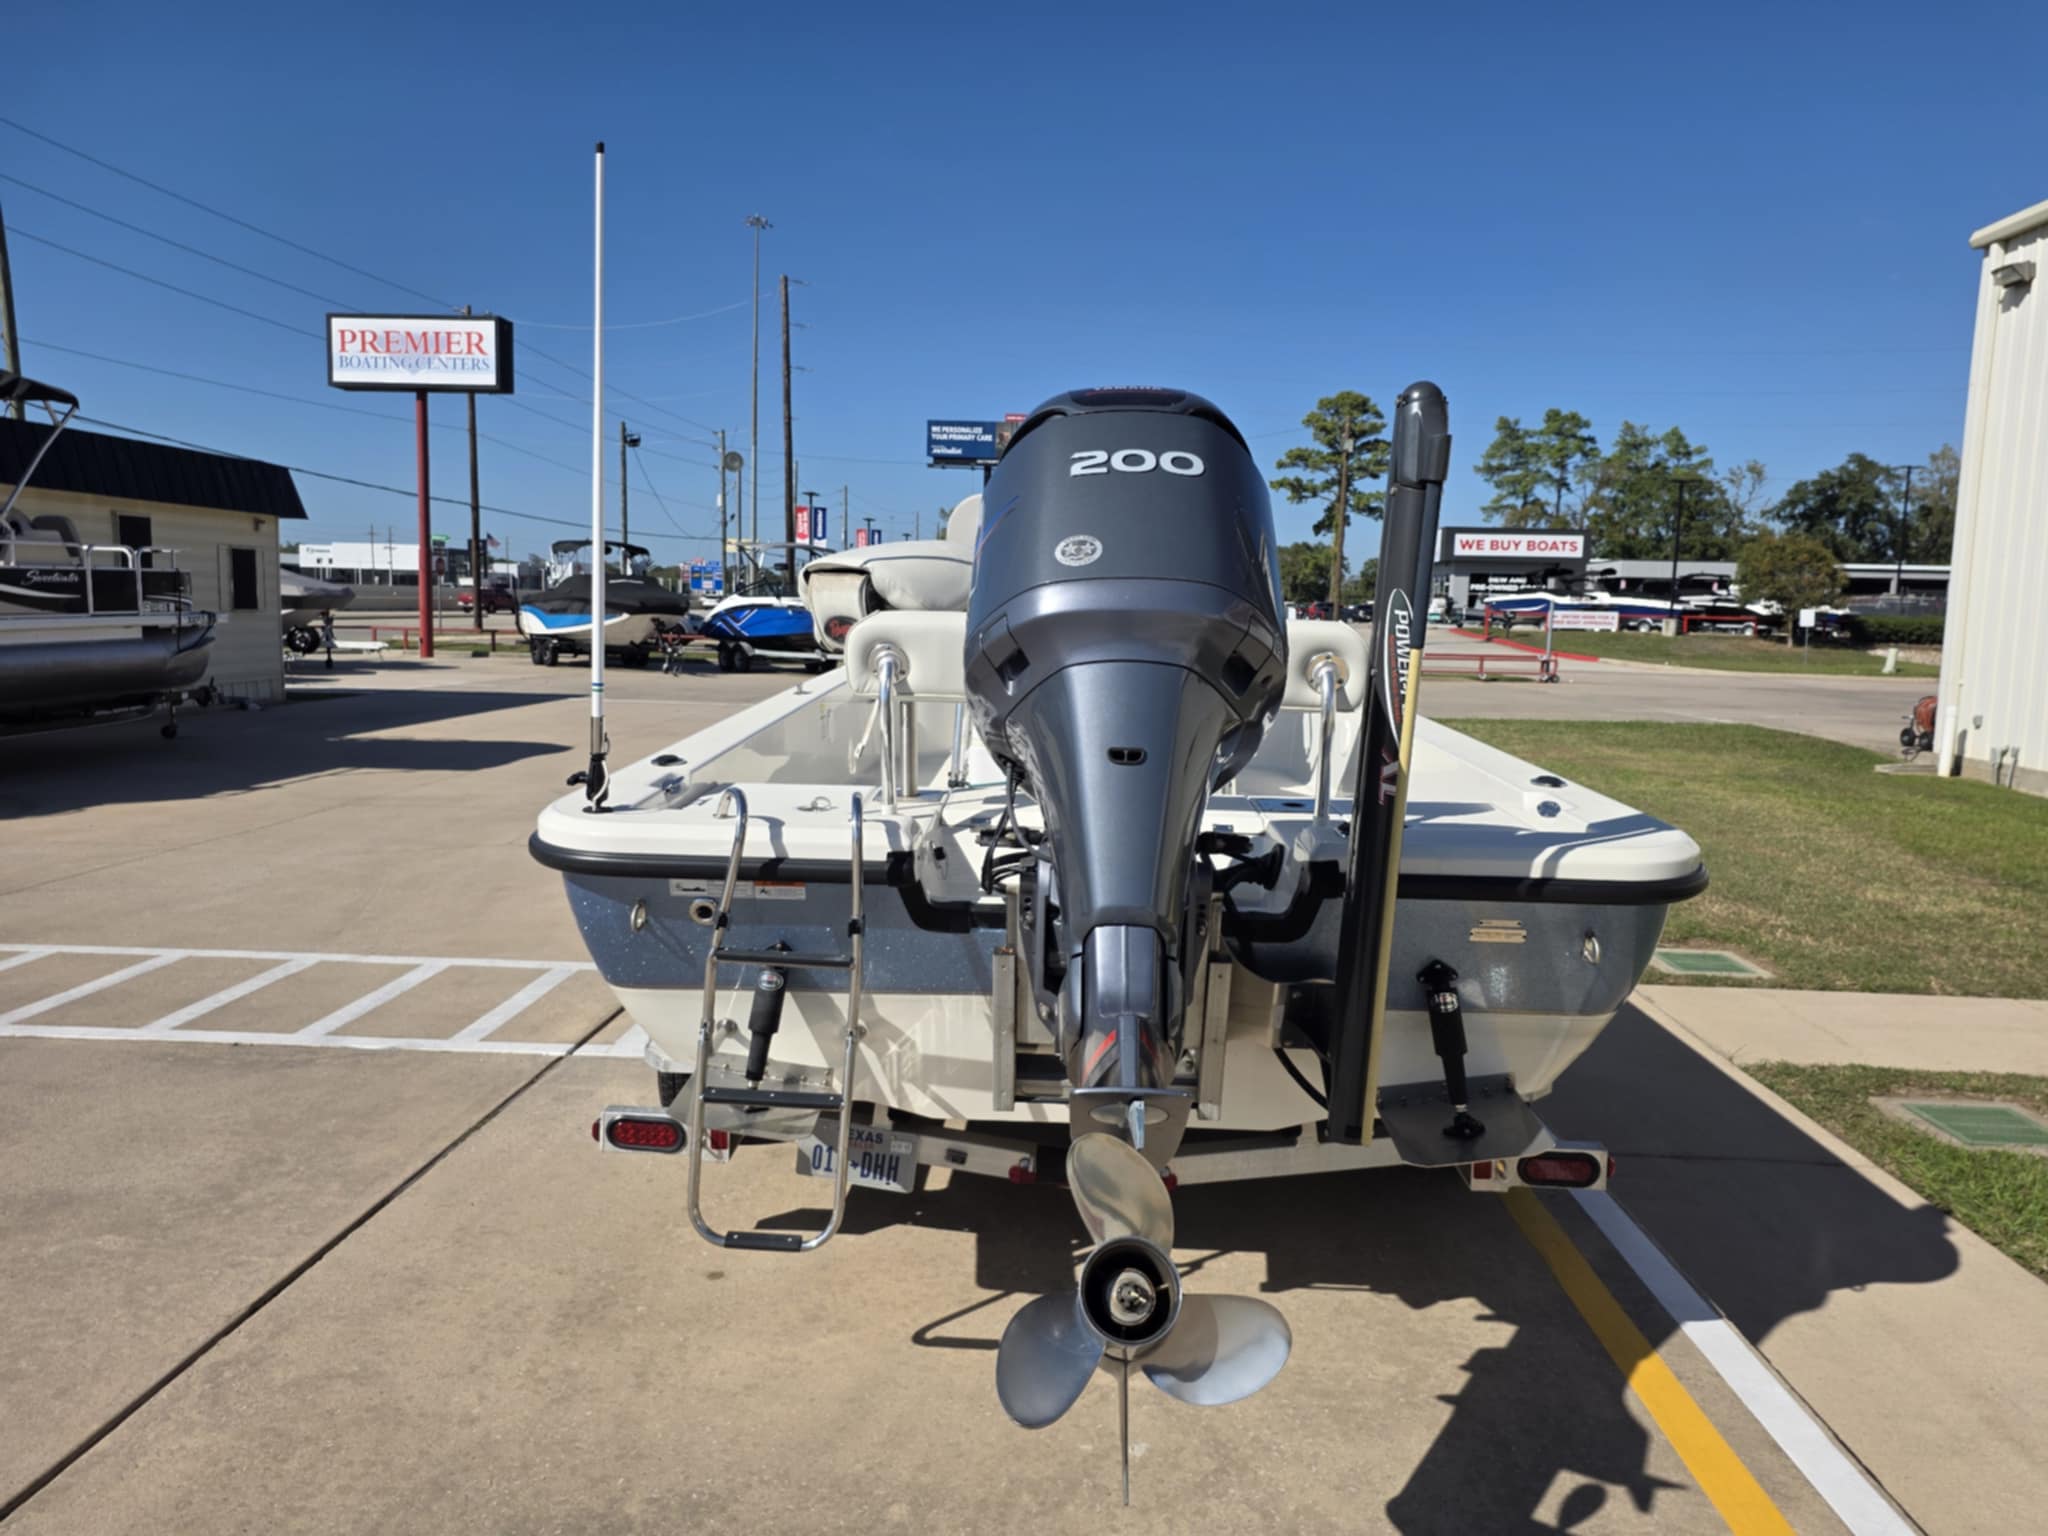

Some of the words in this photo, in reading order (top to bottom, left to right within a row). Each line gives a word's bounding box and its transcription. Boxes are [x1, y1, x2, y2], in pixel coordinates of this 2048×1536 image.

[337, 329, 489, 356] PREMIER
[339, 355, 412, 370] BOATING
[415, 356, 490, 371] CENTERS
[949, 433, 976, 441] PRIMARY
[976, 434, 993, 442] CARE
[1070, 448, 1205, 477] 200
[1460, 538, 1485, 550] WE
[1490, 539, 1521, 551] BUY
[1526, 540, 1578, 552] BOATS
[848, 1127, 883, 1145] EXAS
